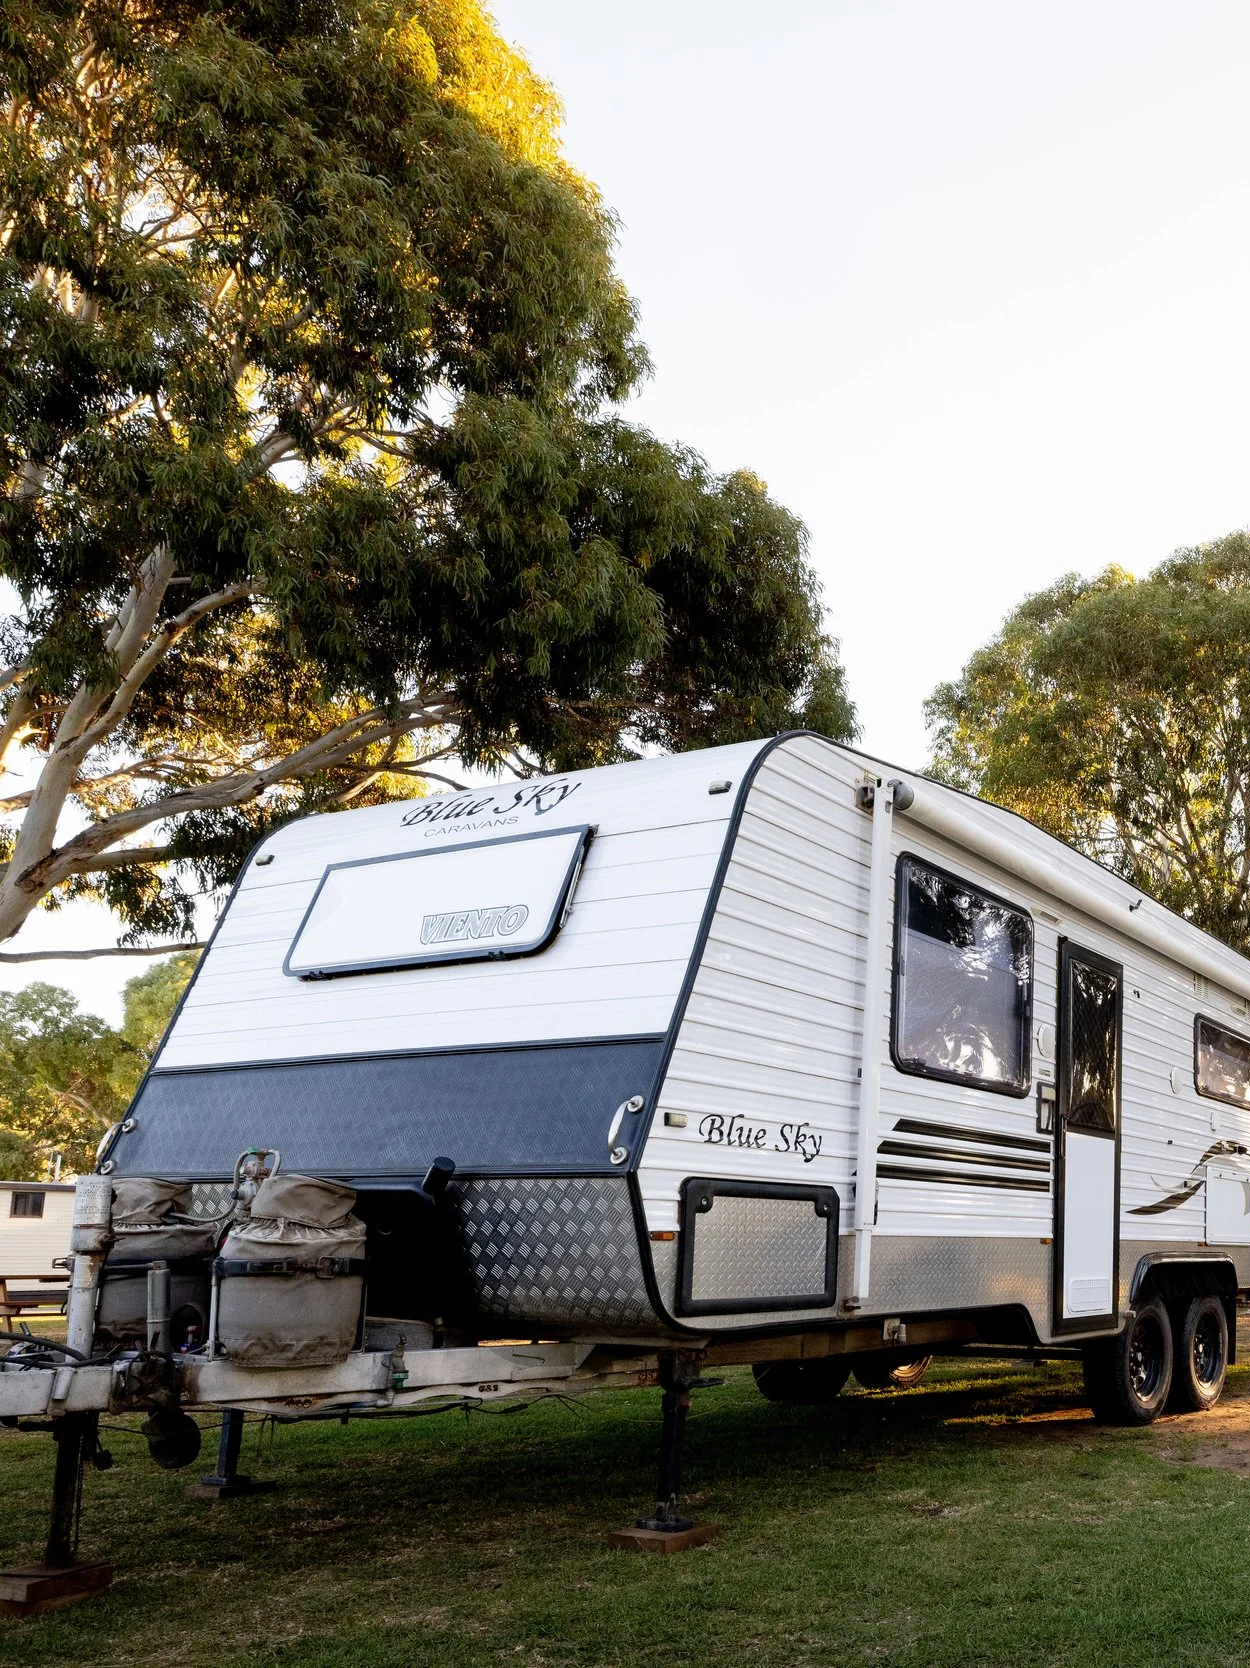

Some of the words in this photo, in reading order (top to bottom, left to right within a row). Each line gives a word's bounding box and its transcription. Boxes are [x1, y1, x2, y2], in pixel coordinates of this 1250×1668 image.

[400, 794, 495, 827] Blue
[493, 778, 582, 816] Sky
[423, 815, 519, 838] CARAVANS
[420, 904, 529, 945] VIENTO
[699, 1114, 766, 1148] Blue
[775, 1122, 822, 1163] Sky
